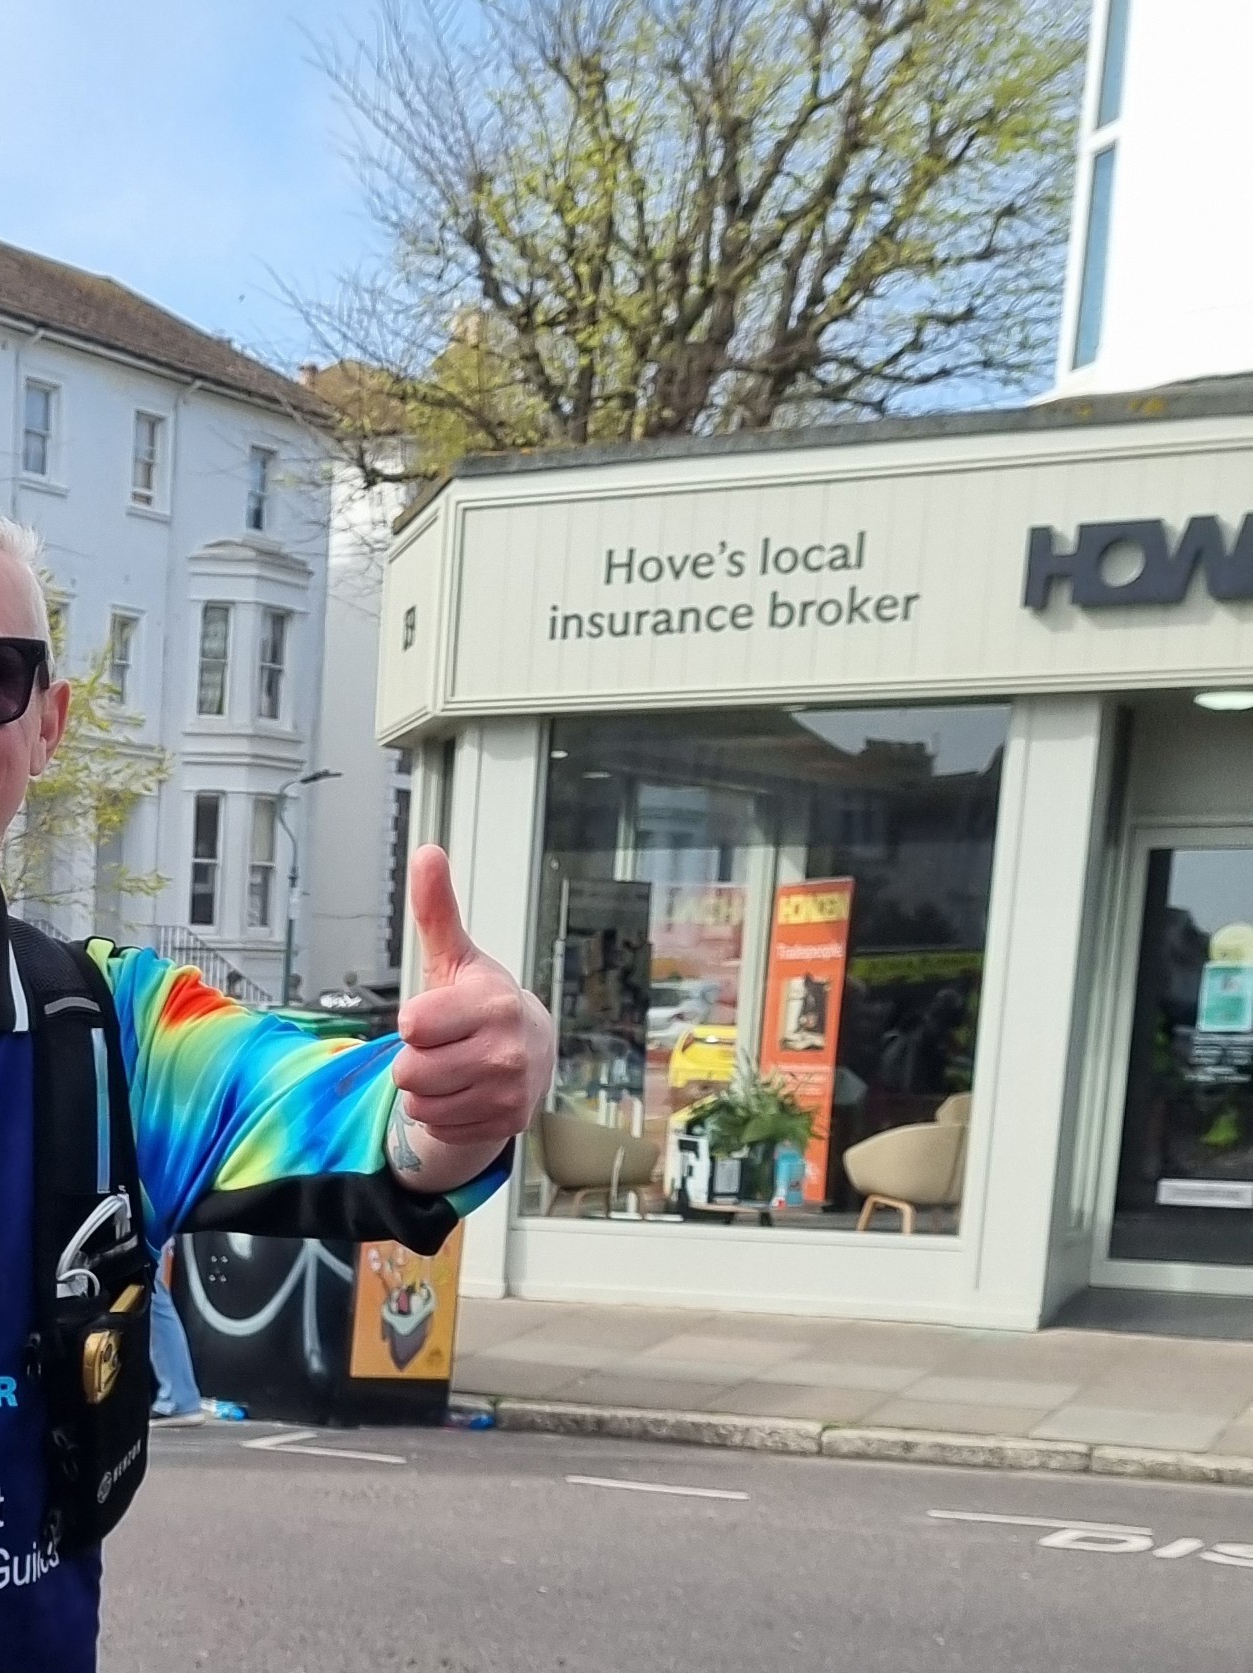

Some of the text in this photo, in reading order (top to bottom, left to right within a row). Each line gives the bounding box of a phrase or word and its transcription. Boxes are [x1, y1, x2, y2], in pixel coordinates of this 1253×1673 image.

[604, 531, 867, 585] Hove's local
[548, 586, 921, 640] insurance broker
